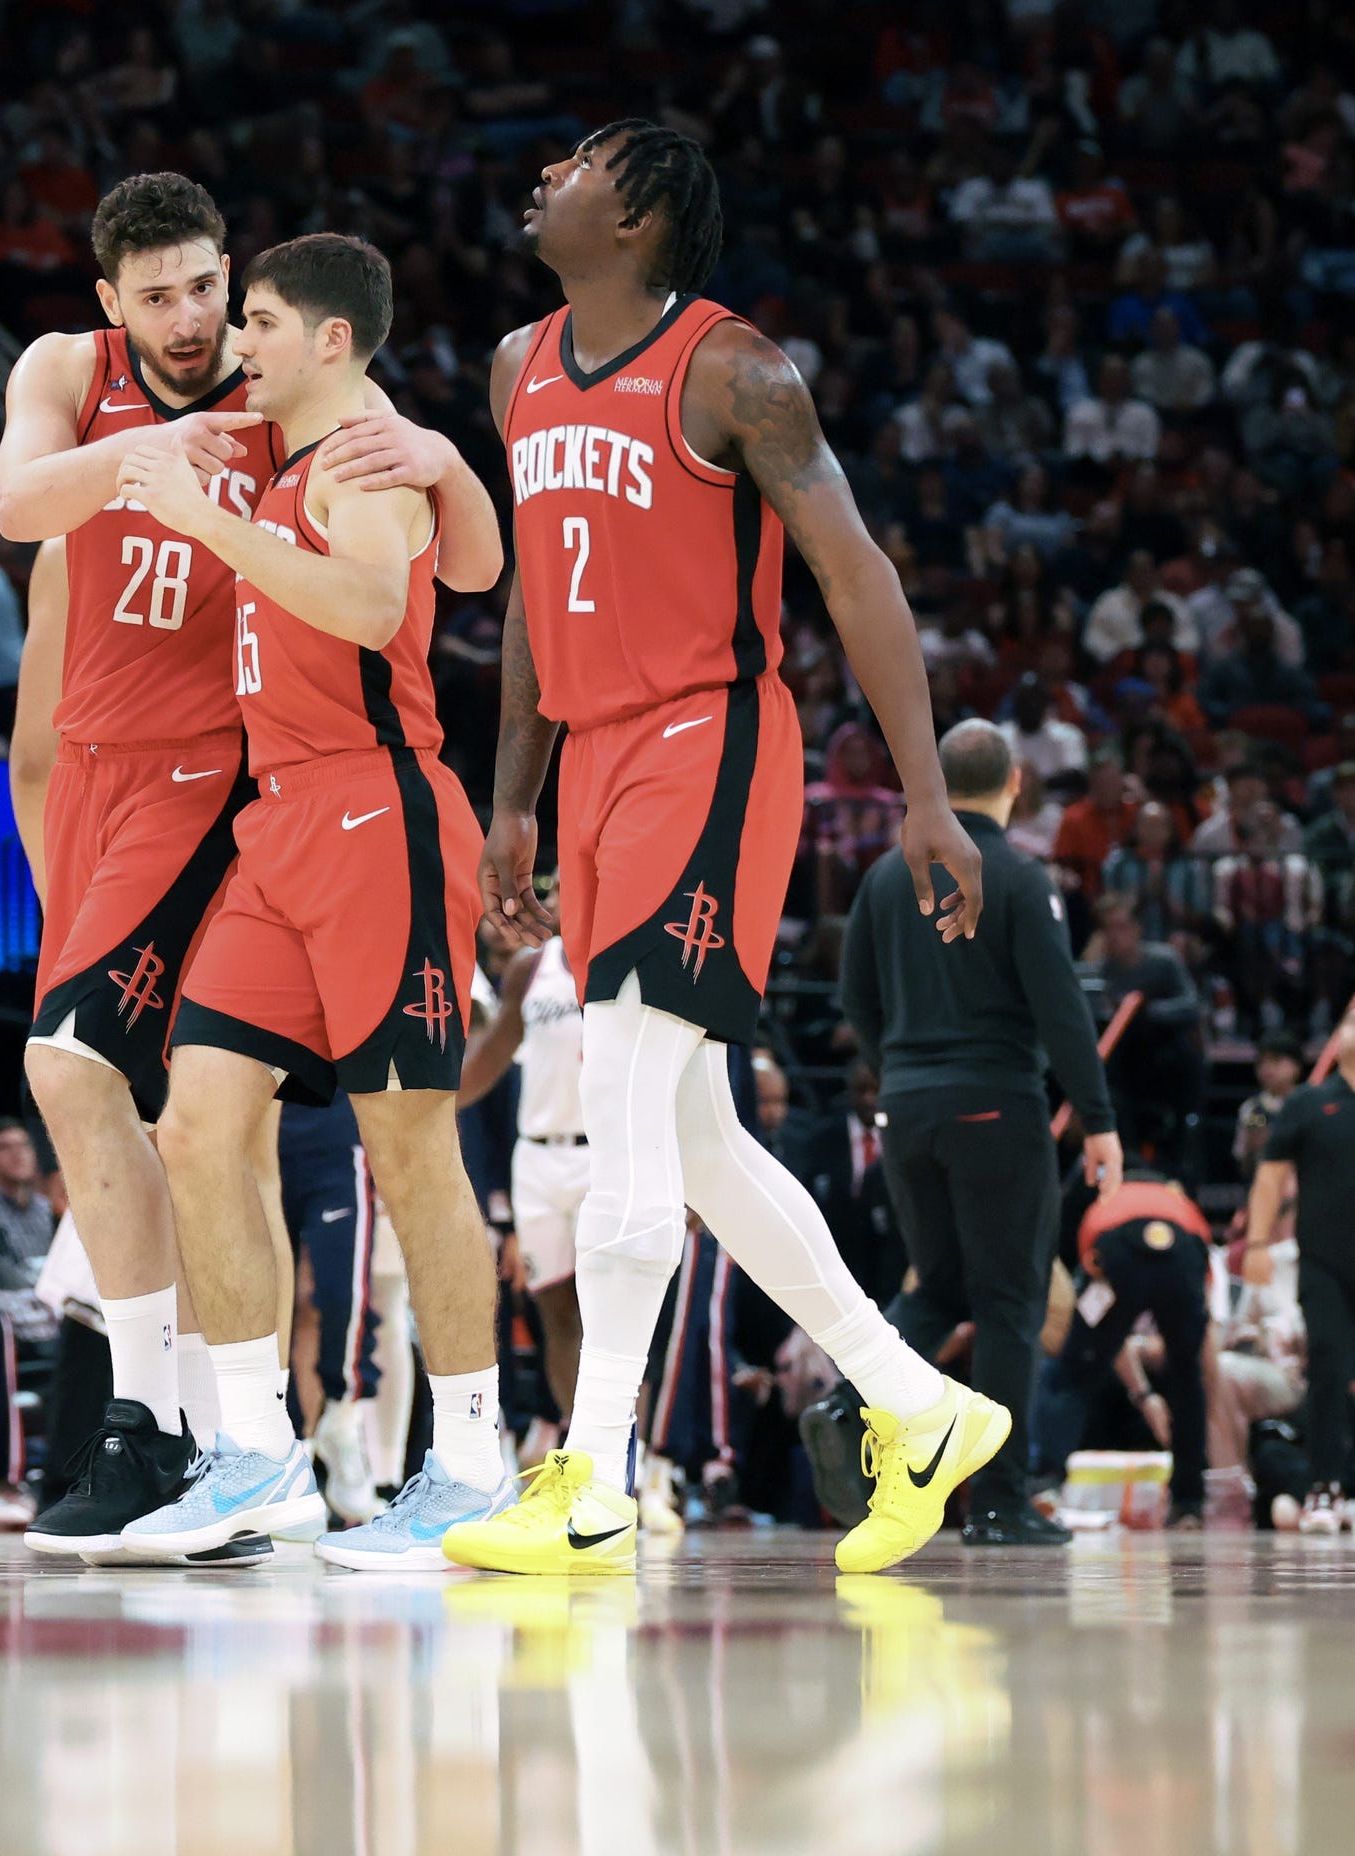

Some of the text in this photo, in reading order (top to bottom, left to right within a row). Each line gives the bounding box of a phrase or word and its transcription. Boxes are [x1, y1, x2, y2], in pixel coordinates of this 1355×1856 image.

[613, 383, 662, 395] HERMANN
[614, 376, 663, 388] MEMORIAL
[512, 425, 654, 510] ROCKETS
[113, 535, 193, 631] 28
[562, 516, 596, 612] 2
